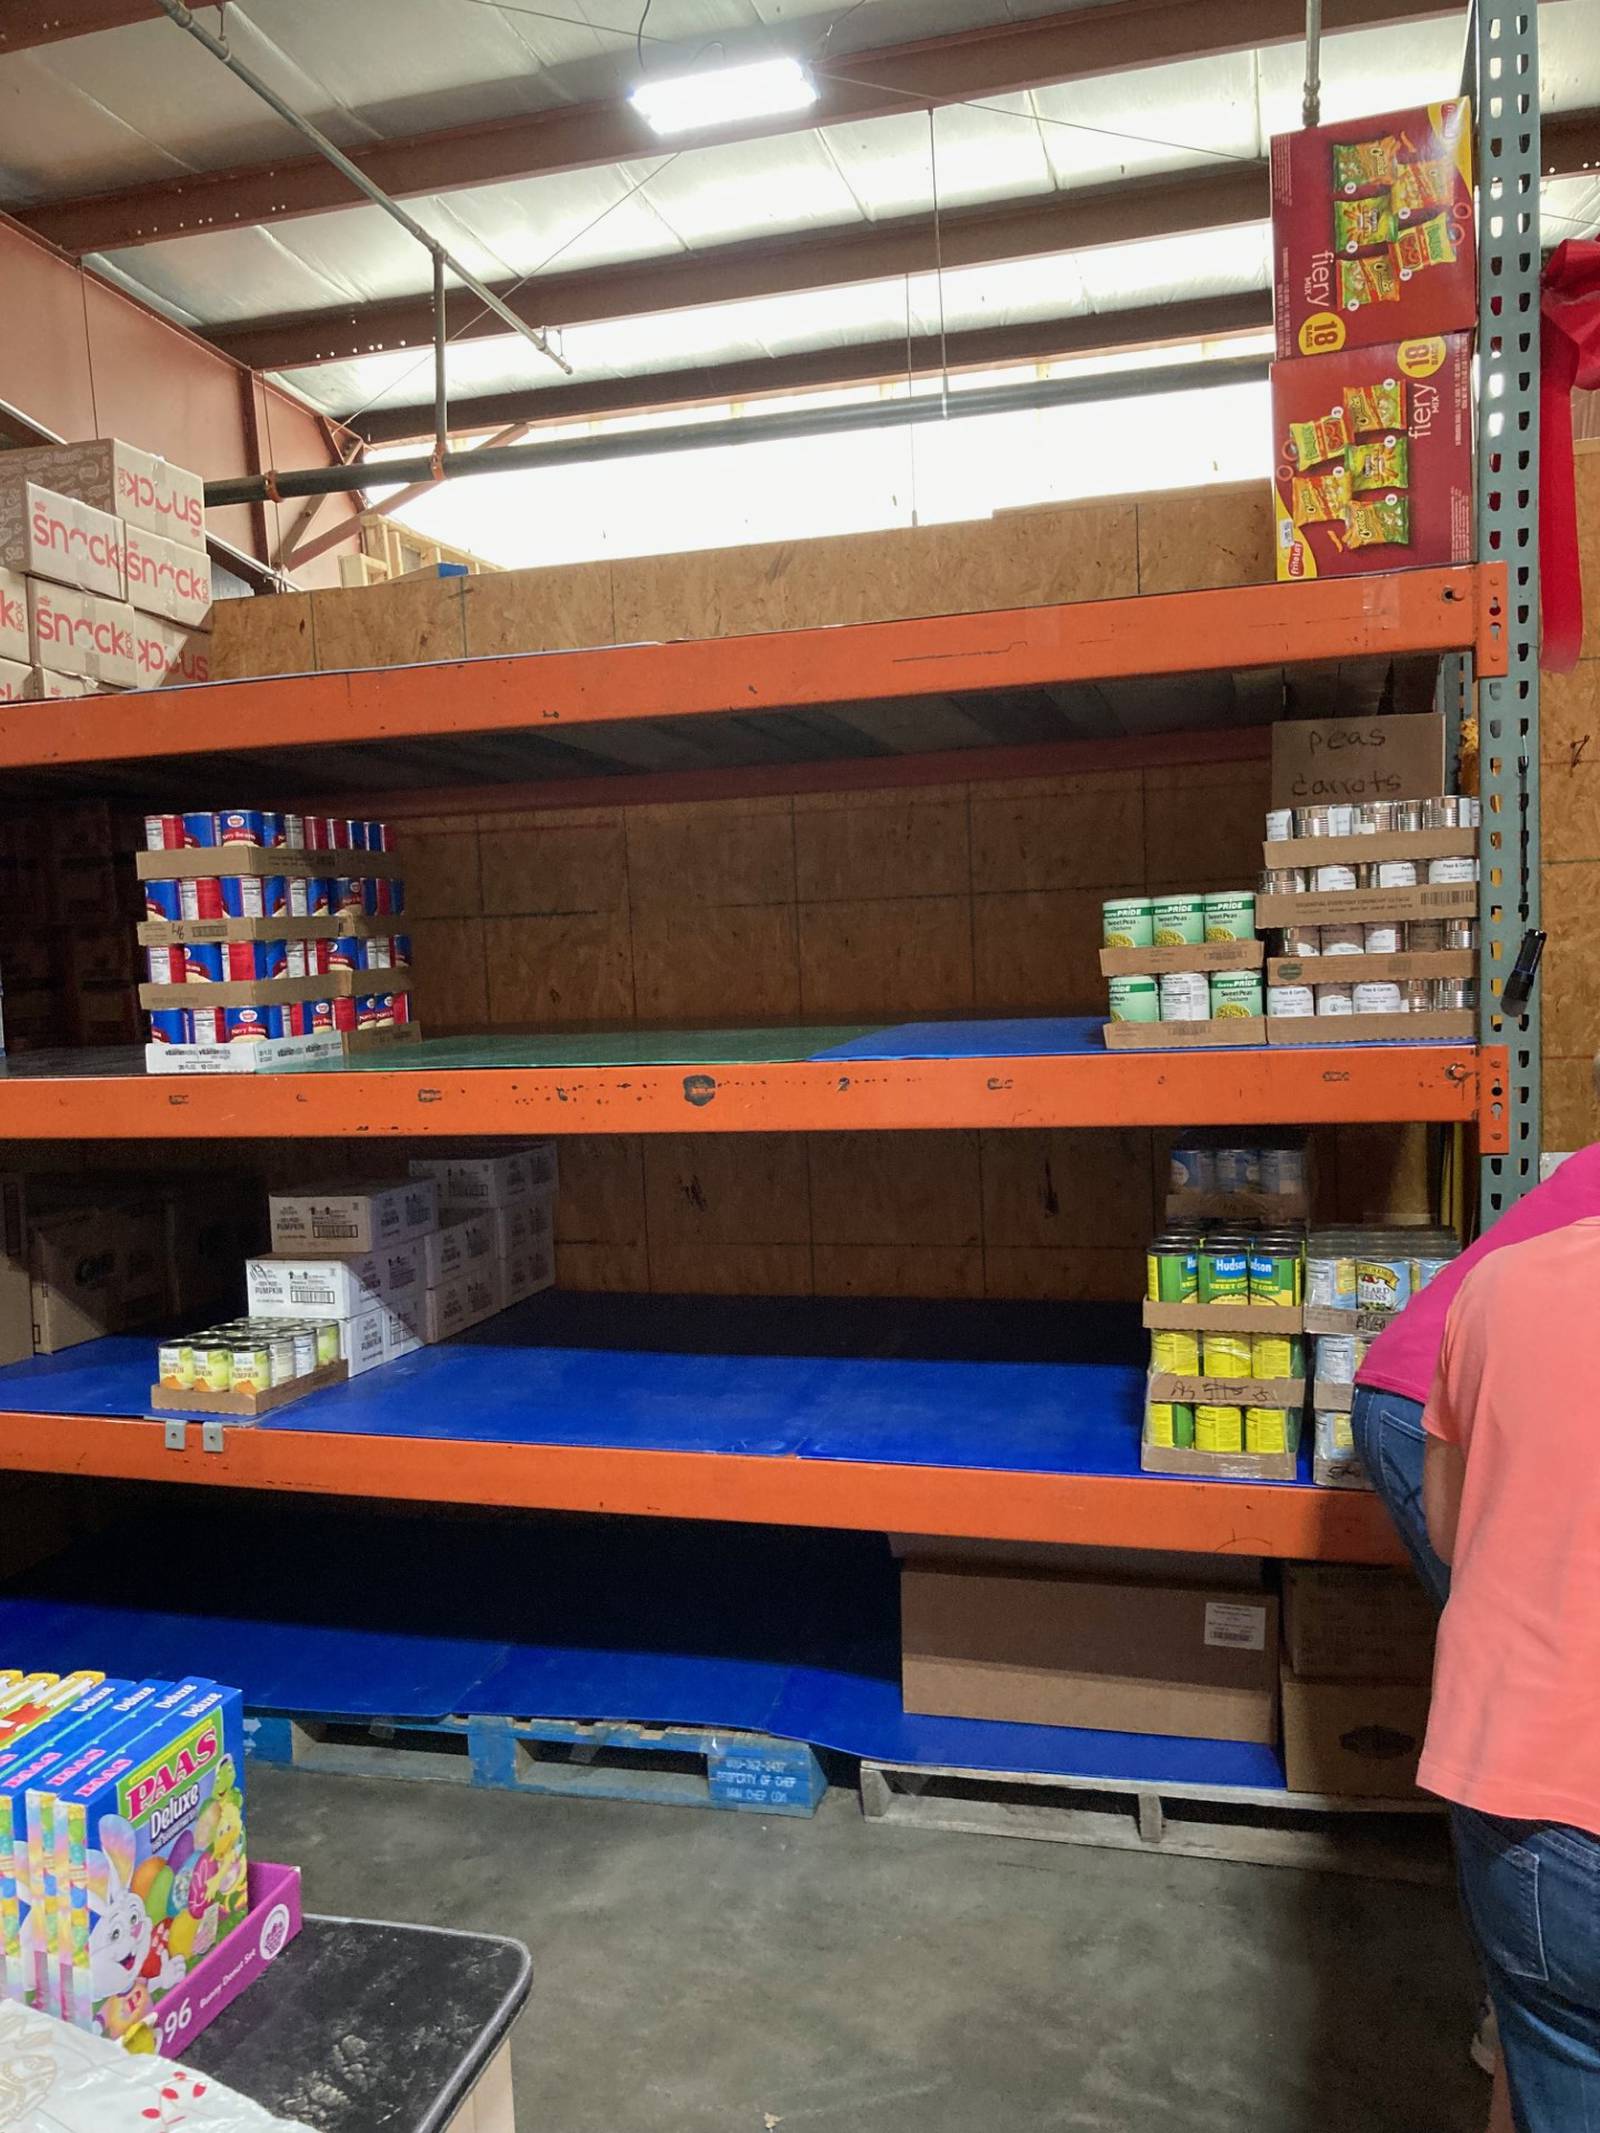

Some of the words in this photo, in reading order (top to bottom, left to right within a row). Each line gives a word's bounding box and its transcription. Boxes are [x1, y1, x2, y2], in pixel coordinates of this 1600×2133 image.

[1307, 250, 1334, 307] fiery
[1314, 321, 1338, 346] 18
[1405, 344, 1430, 369] 18
[1408, 383, 1436, 439] fiery
[126, 1726, 218, 1821] PAAS
[150, 1783, 199, 1839] Deluxe
[164, 1997, 192, 2043] 96
